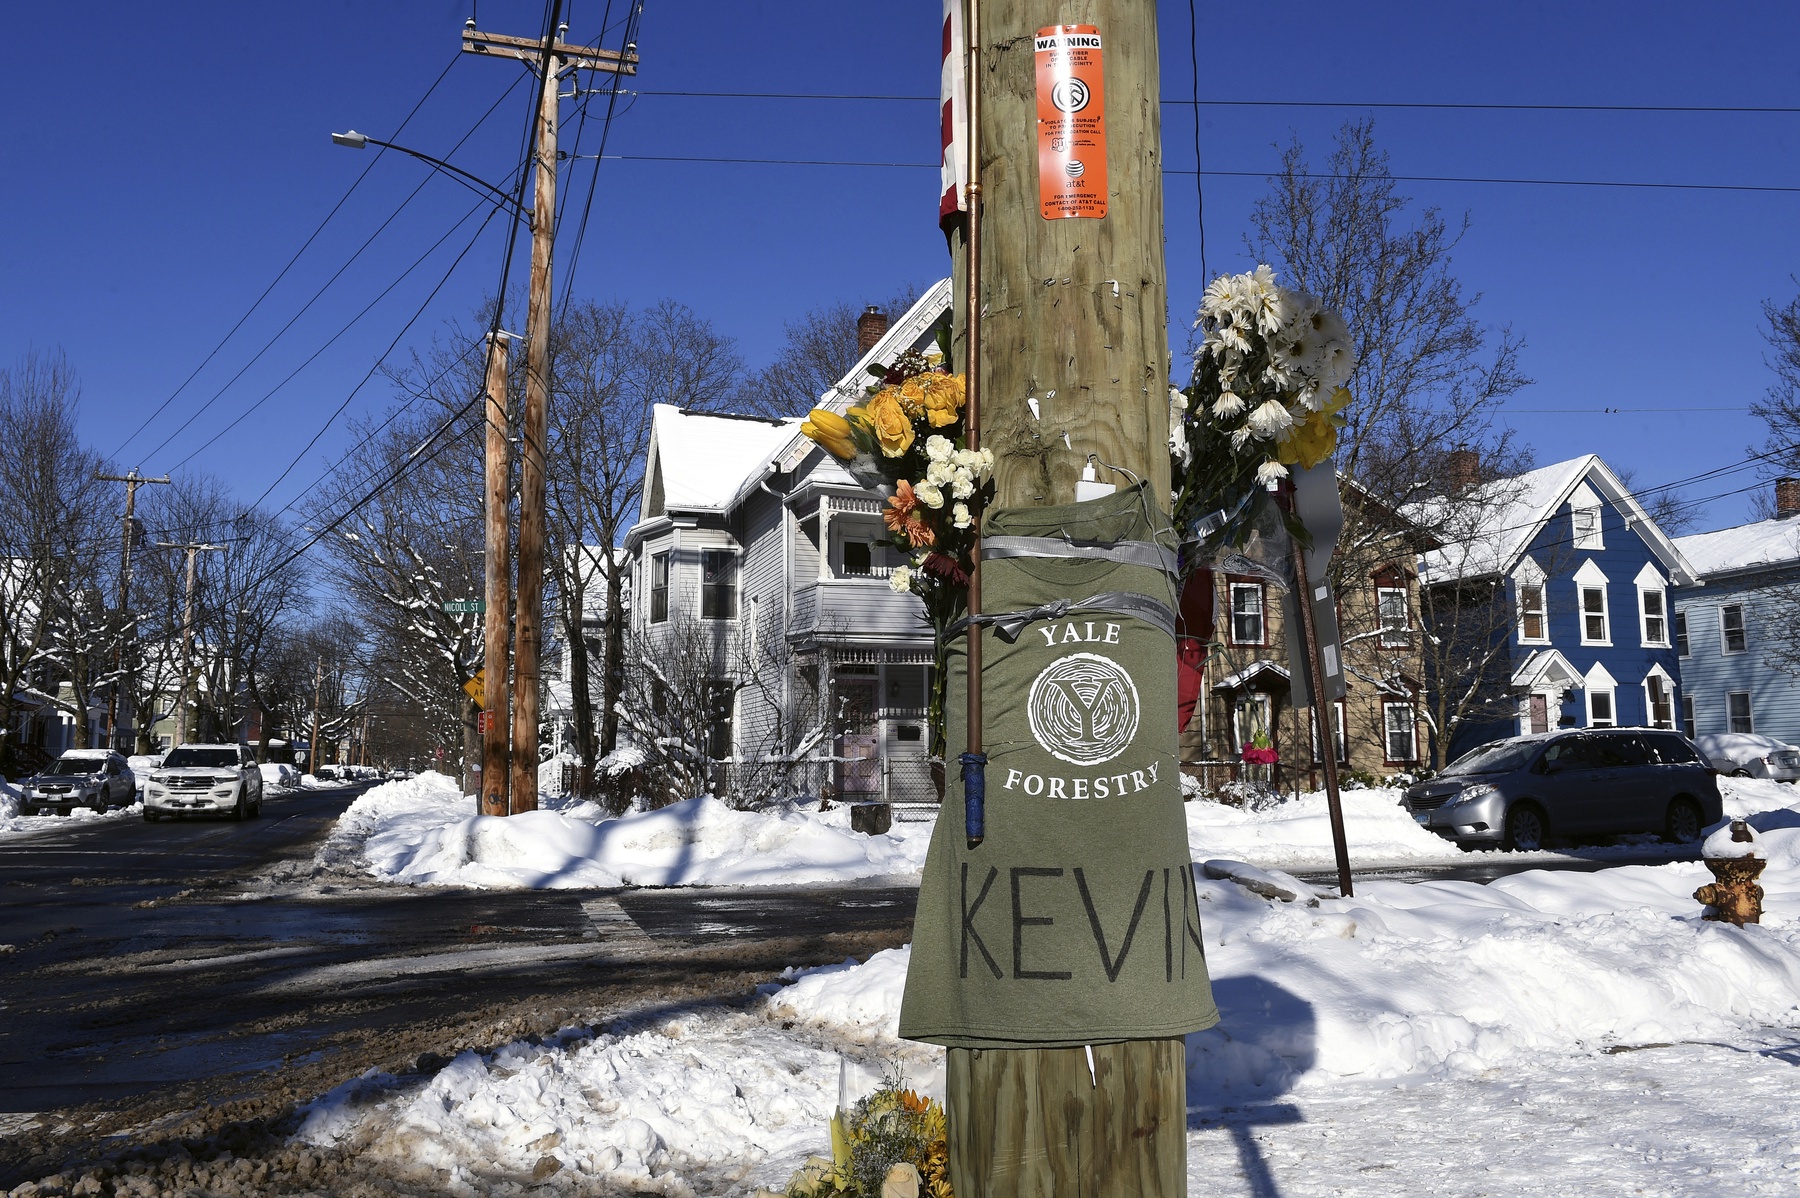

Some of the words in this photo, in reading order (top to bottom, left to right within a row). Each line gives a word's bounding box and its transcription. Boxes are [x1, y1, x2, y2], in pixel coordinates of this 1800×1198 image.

[1037, 38, 1099, 49] WANING
[444, 602, 468, 612] NICOLL
[470, 602, 479, 612] ST
[1038, 621, 1121, 647] YALE
[1003, 761, 1160, 800] FORESTRY
[960, 862, 1205, 983] KEVIN
